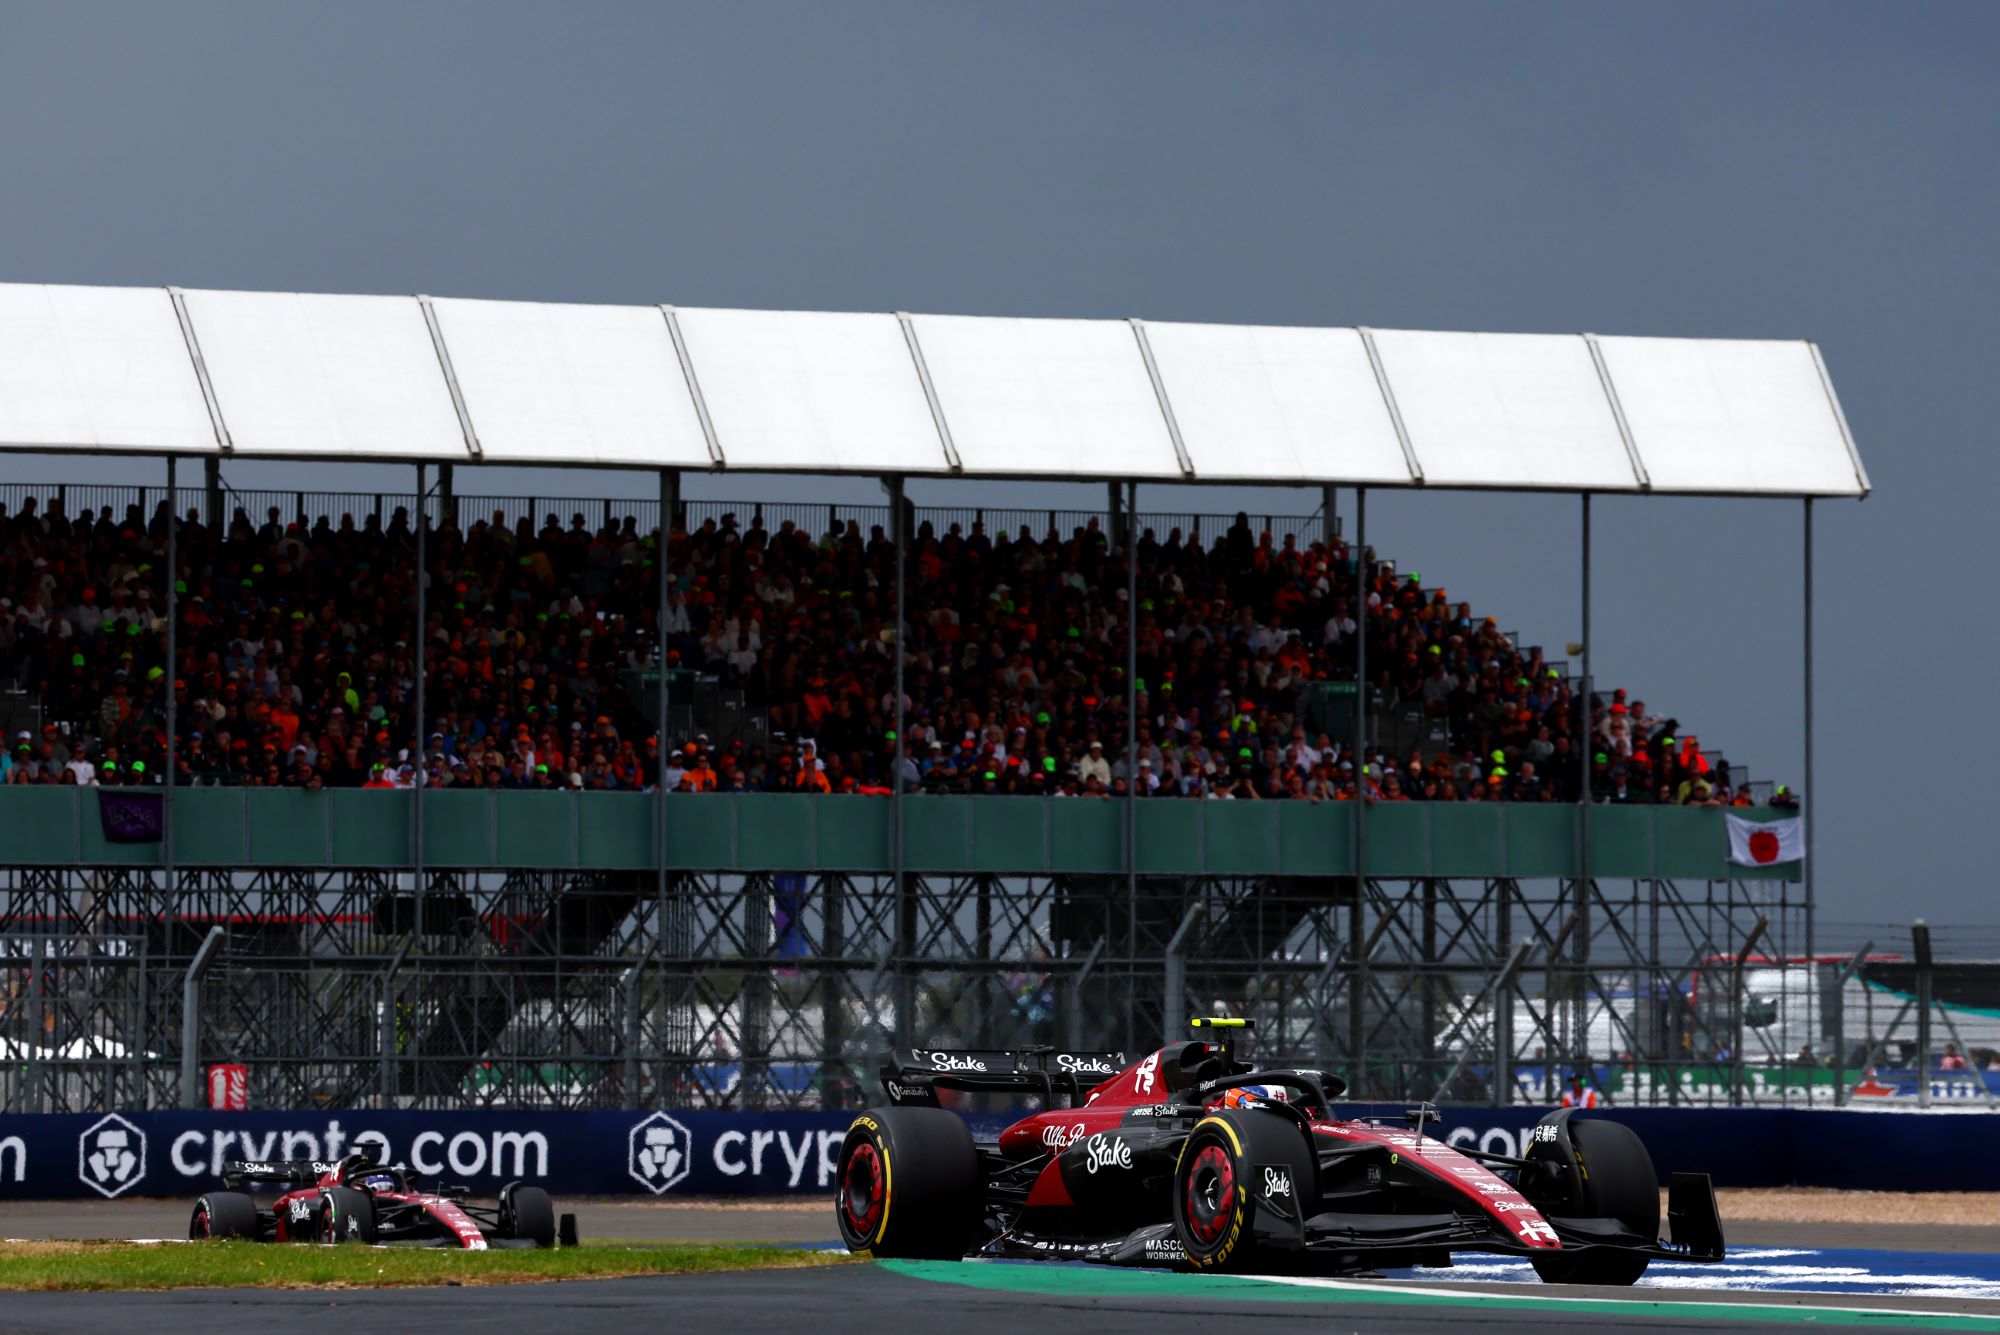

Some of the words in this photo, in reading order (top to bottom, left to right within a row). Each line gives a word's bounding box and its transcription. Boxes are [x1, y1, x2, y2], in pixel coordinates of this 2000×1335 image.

[931, 1051, 988, 1072] Stake
[1056, 1054, 1114, 1074] Stake
[1154, 1104, 1178, 1117] Stake
[170, 1119, 549, 1177] crypto.com
[1042, 1125, 1068, 1156] Alfa
[712, 1129, 848, 1188] cryp
[1086, 1132, 1134, 1175] Stake
[243, 1162, 275, 1173] Stake
[1264, 1166, 1290, 1198] Stake
[290, 1200, 311, 1224] Stake
[1145, 1239, 1184, 1251] MASCO
[1217, 1207, 1245, 1263] ZERO
[1145, 1251, 1188, 1260] WORKWEA
